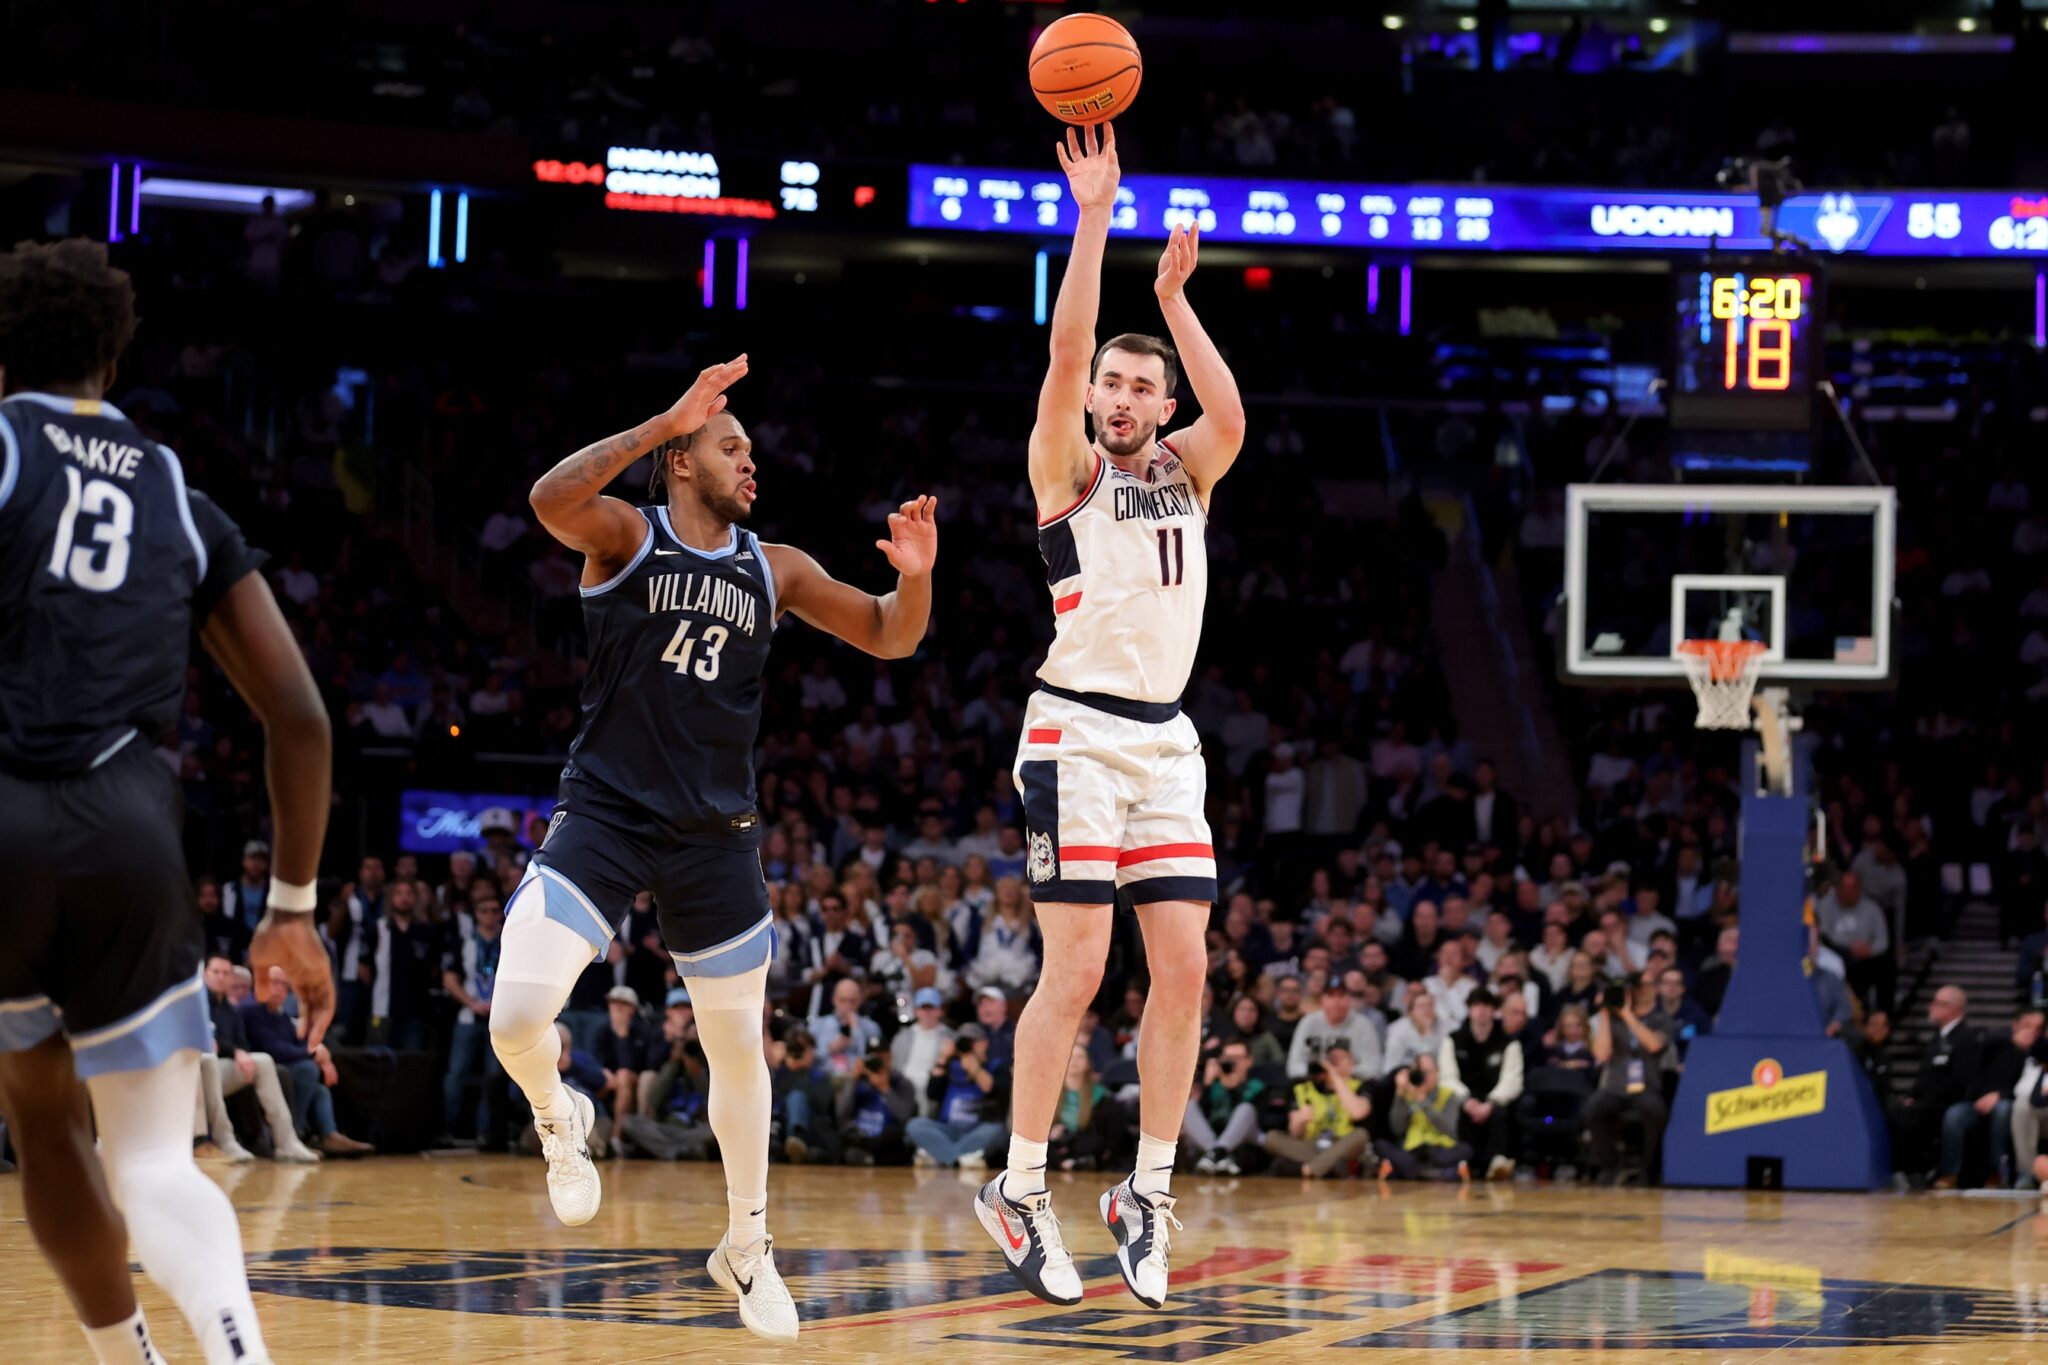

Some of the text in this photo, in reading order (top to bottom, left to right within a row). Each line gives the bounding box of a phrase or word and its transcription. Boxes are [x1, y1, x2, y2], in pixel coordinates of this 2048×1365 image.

[1057, 91, 1116, 116] ELITE
[1590, 205, 1734, 238] UCONN
[1907, 202, 1961, 239] 55
[1988, 215, 2048, 250] 6:2
[1712, 277, 1801, 320] 6:20
[1724, 318, 1792, 390] 18
[48, 465, 134, 592] 13
[1157, 528, 1183, 586] 11
[648, 573, 756, 637] VILLANOVA
[661, 619, 730, 682] 43
[1713, 1083, 1818, 1126] Schweppes
